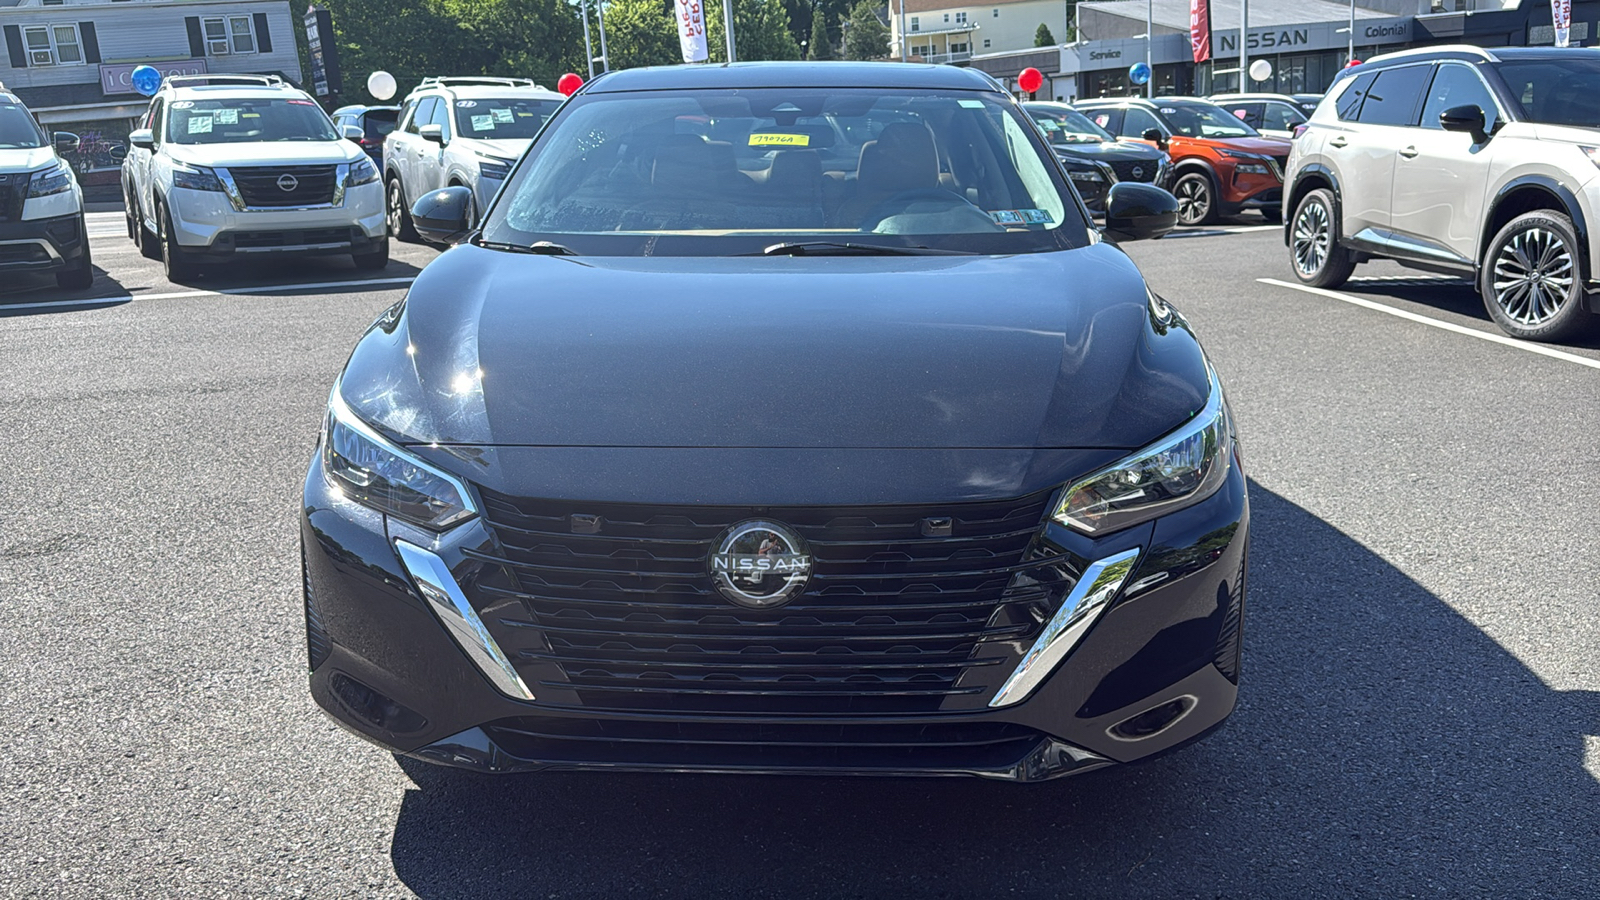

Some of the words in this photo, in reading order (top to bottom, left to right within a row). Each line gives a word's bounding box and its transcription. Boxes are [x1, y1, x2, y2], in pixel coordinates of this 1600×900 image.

[1365, 24, 1407, 38] Colonial
[1220, 29, 1308, 52] NISSAN
[1089, 48, 1122, 61] Service
[714, 557, 806, 571] NISSAN
